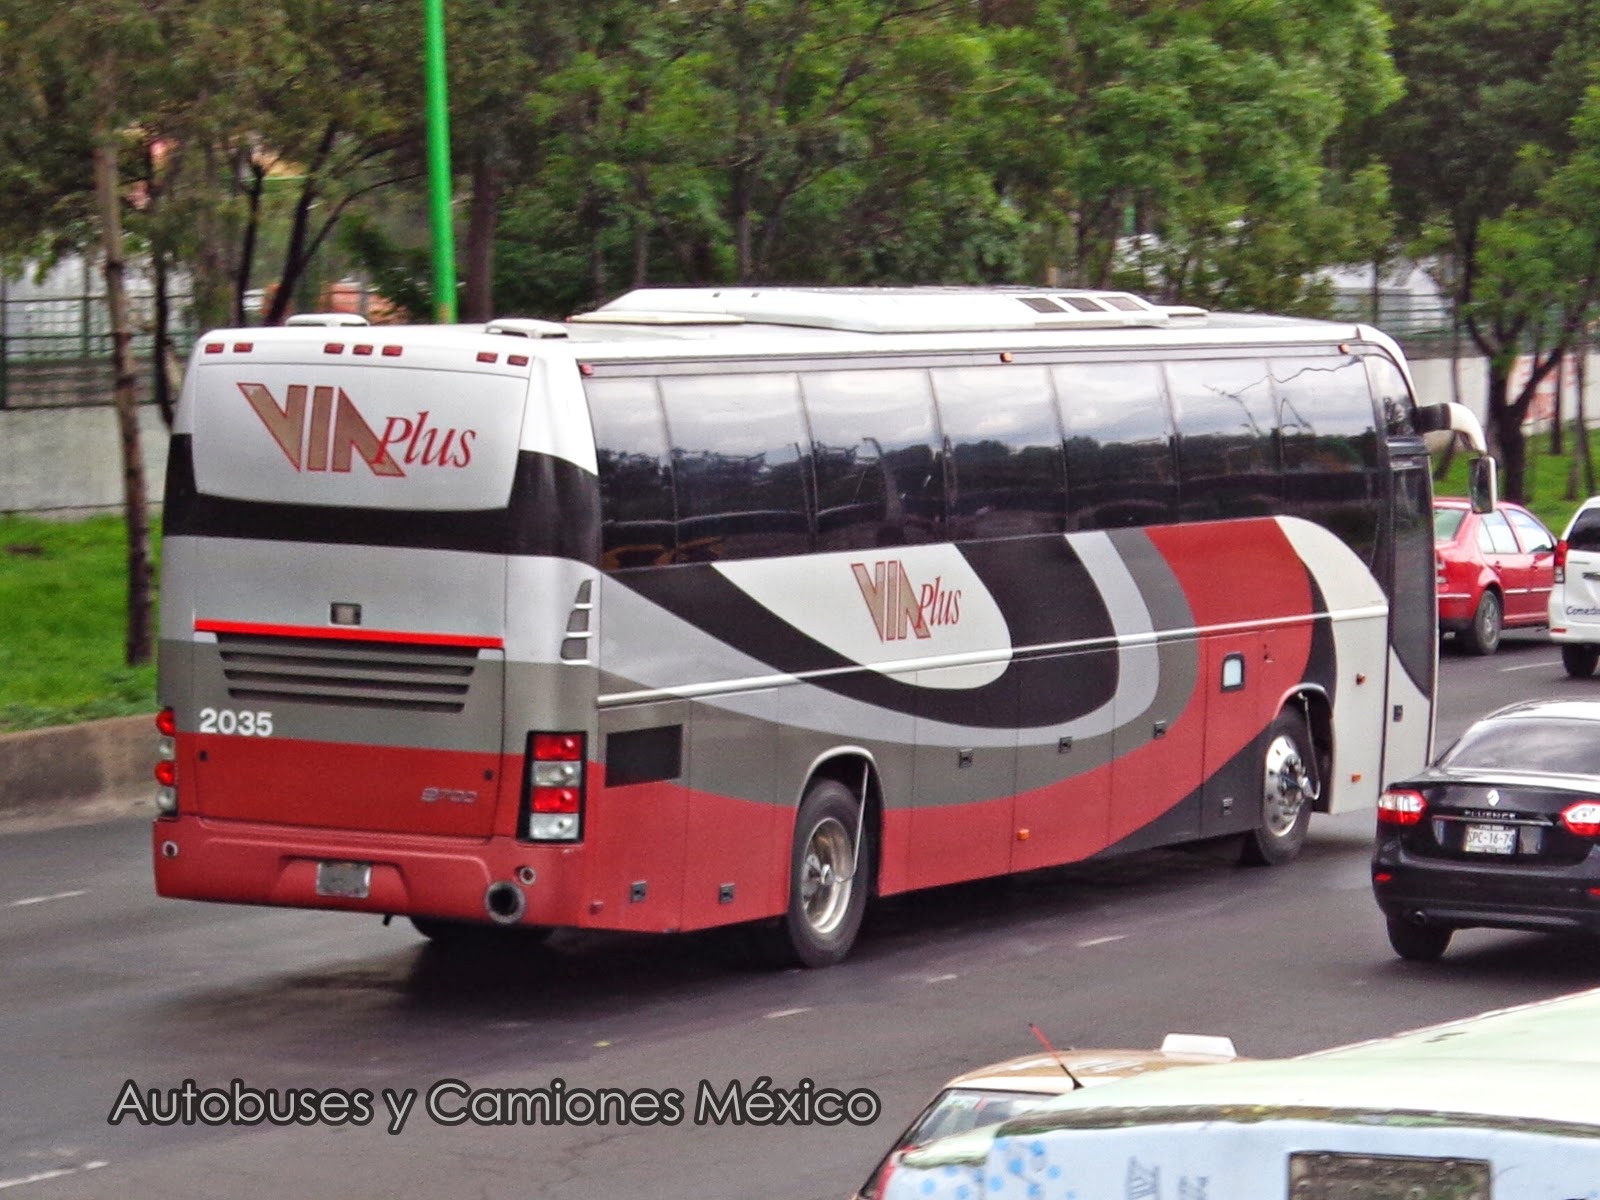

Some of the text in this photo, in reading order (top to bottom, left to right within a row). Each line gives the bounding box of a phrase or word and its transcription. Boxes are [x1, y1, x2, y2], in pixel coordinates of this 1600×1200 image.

[368, 410, 477, 468] Plus
[914, 575, 962, 628] Plus
[199, 707, 273, 737] 2035
